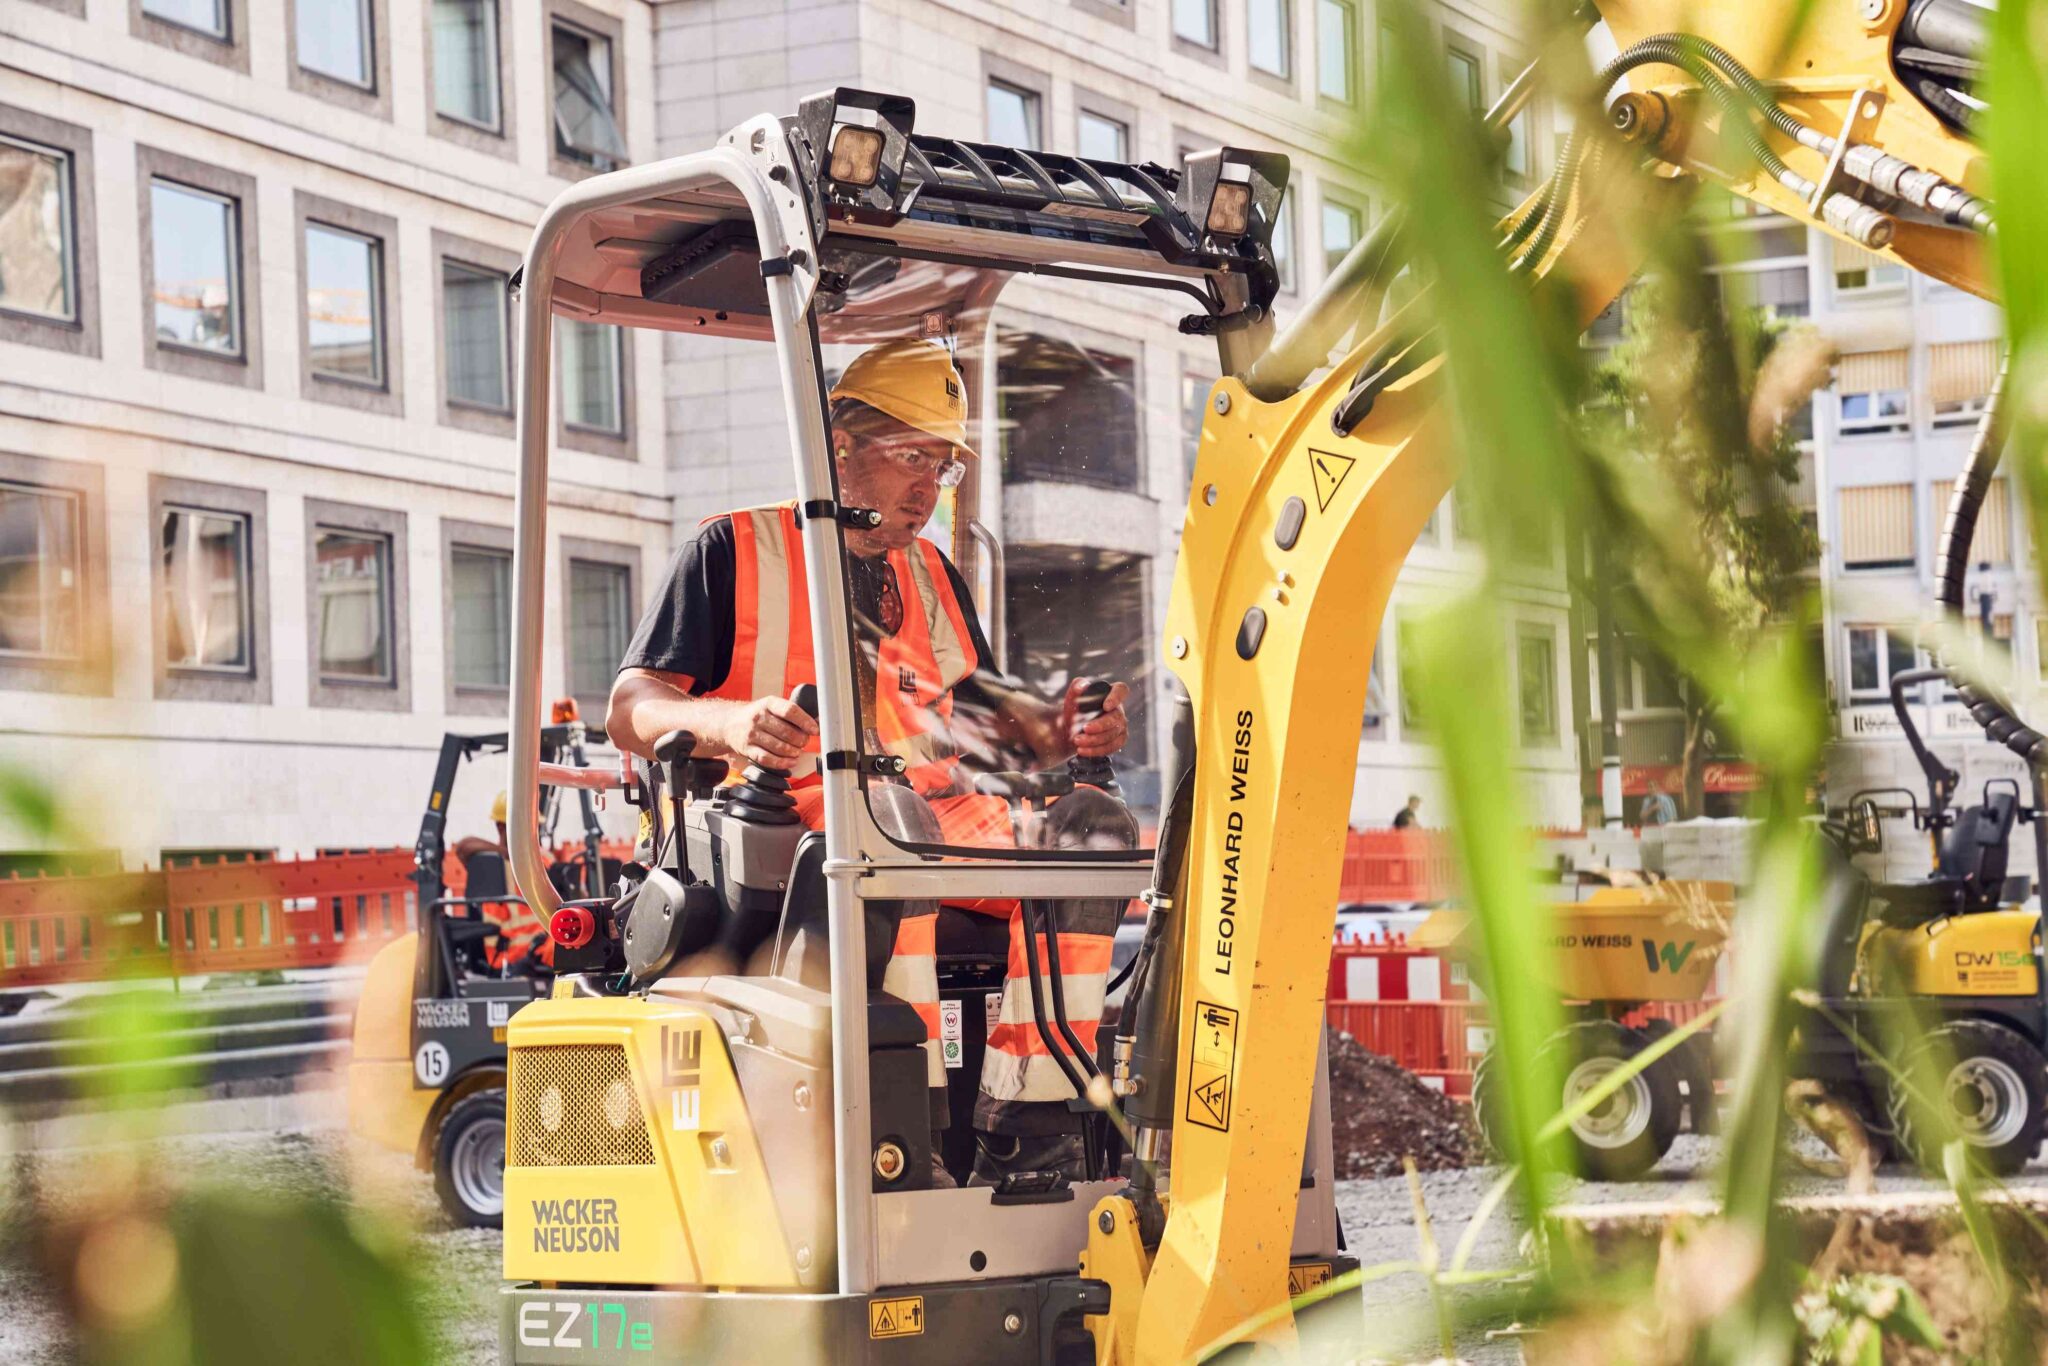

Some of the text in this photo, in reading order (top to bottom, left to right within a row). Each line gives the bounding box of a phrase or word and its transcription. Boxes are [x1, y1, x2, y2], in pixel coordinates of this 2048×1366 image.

[1215, 709, 1253, 975] LEONHARD WEISS
[1582, 935, 1632, 949] WEISS
[417, 1003, 468, 1017] WACKER
[417, 1015, 470, 1028] NEUSON
[423, 1050, 442, 1077] 15
[531, 1198, 619, 1226] WACKER
[533, 1226, 620, 1253] NEUSON
[519, 1301, 653, 1351] EZ17e
